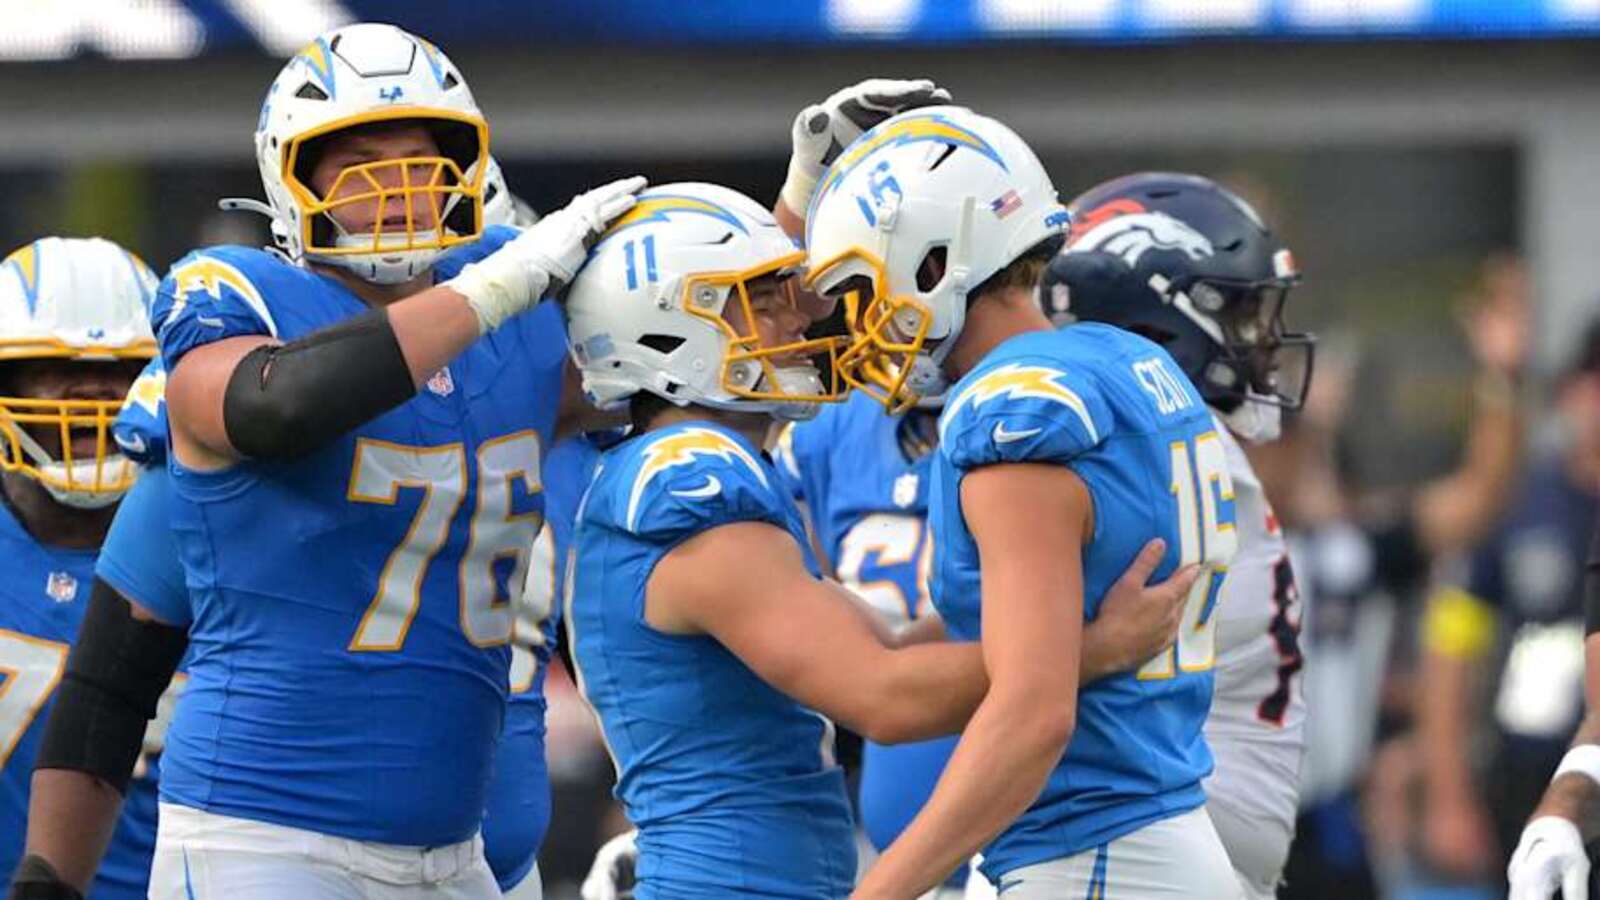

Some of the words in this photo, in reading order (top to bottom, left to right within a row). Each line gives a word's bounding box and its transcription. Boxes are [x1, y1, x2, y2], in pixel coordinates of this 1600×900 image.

[856, 161, 903, 227] 16
[623, 234, 658, 291] 11
[347, 428, 543, 652] 76
[837, 513, 935, 634] 6
[1137, 430, 1236, 681] 16
